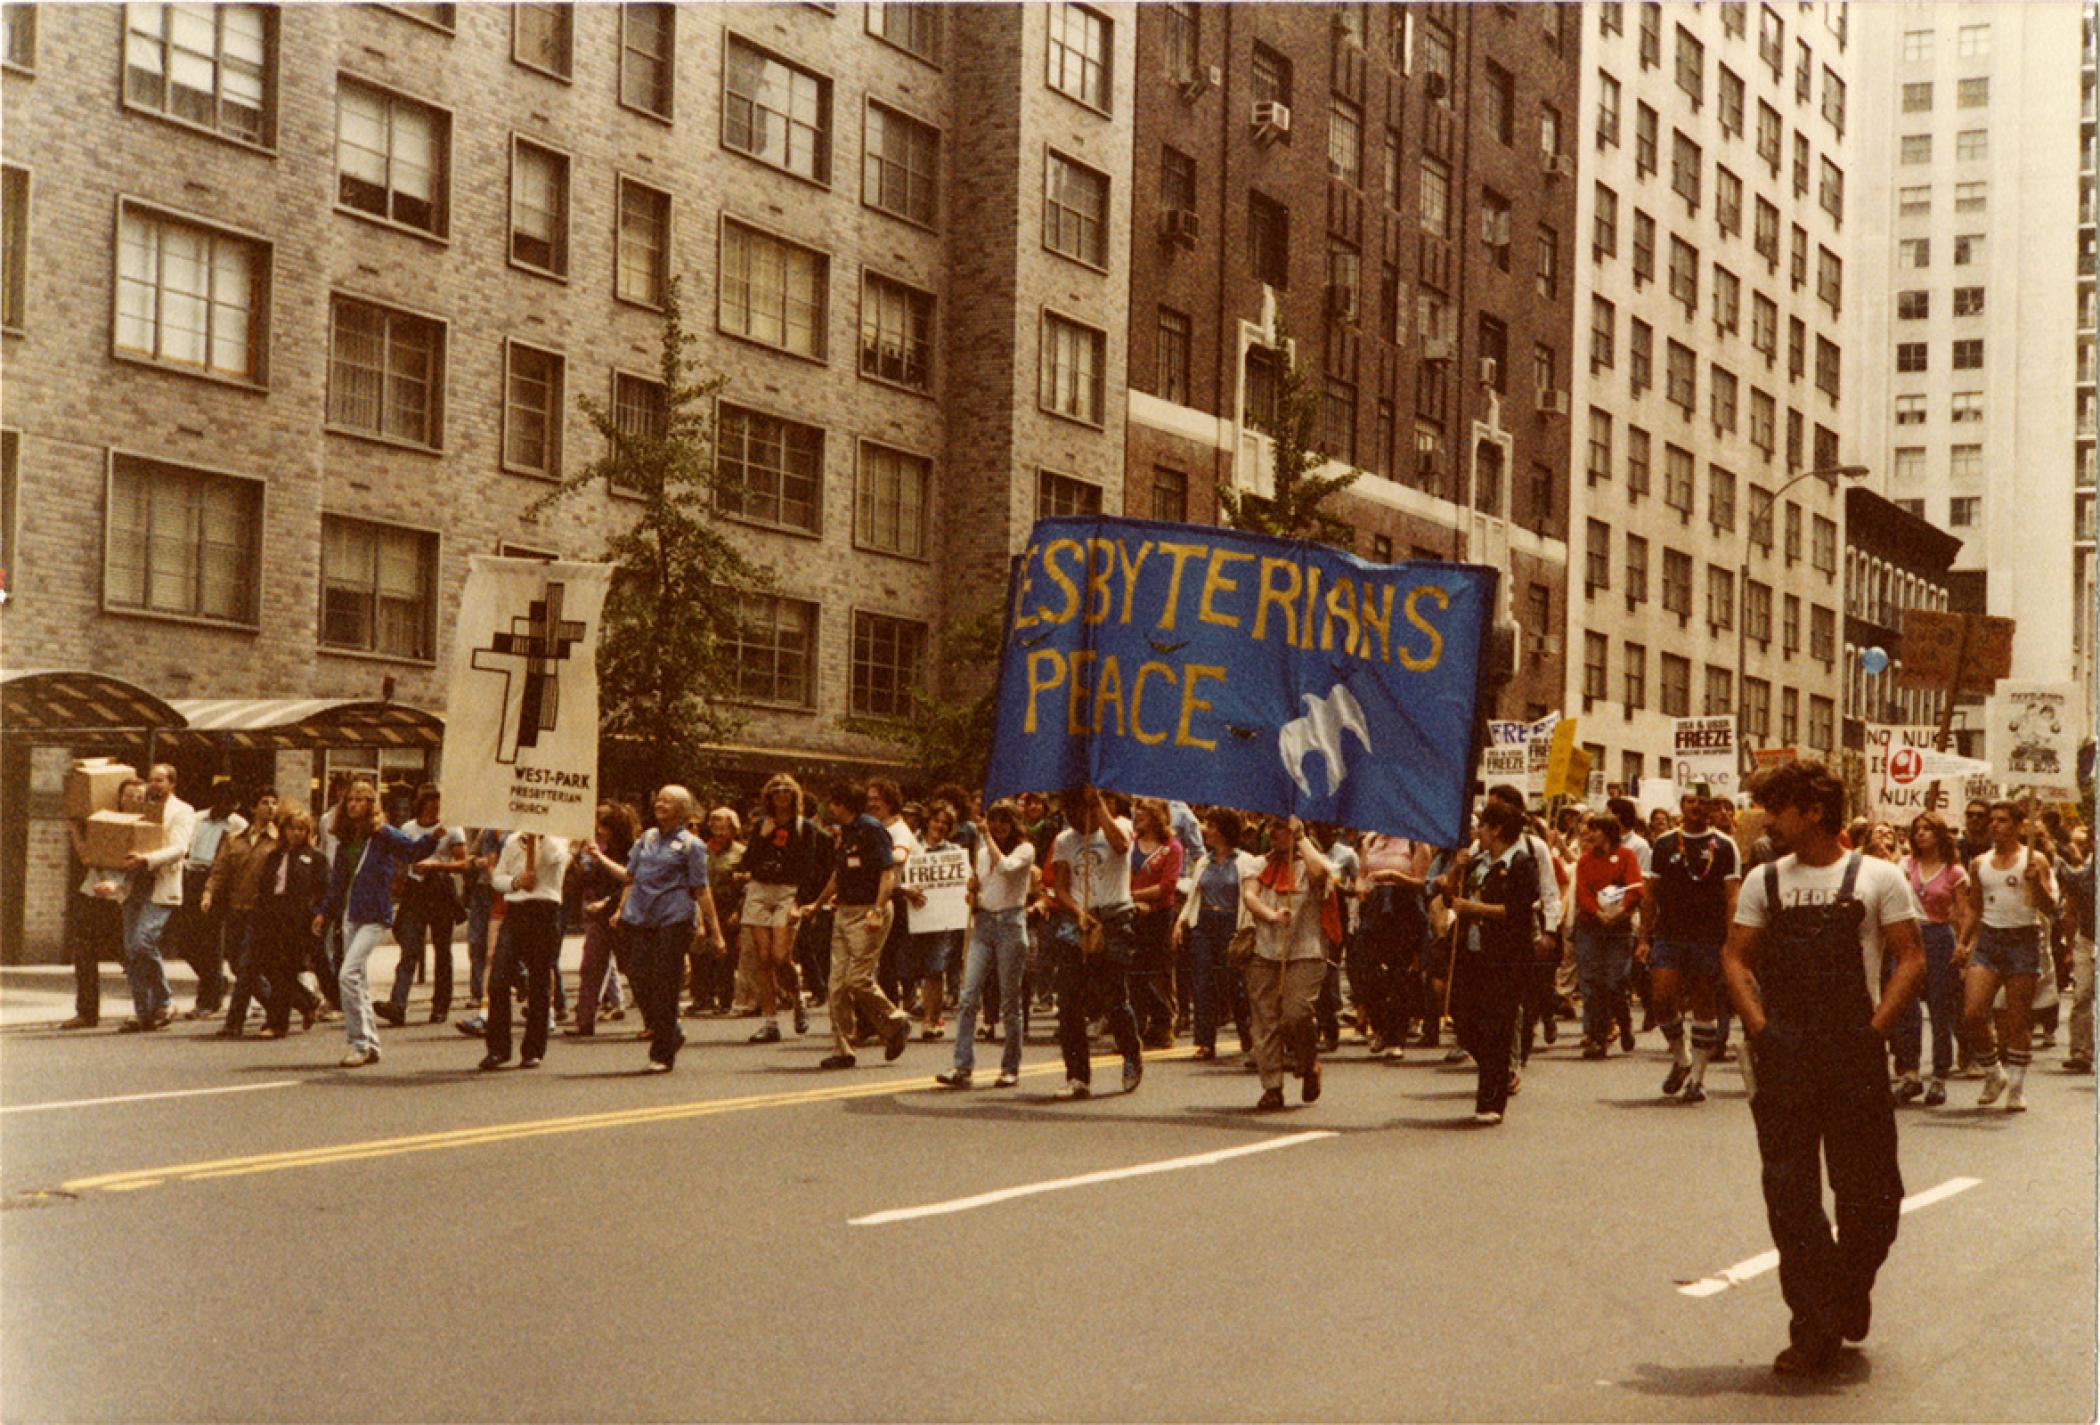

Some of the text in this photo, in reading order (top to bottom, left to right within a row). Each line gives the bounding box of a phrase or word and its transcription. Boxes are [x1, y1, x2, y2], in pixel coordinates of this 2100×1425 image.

[1023, 649, 1227, 752] PEACE
[1676, 730, 1732, 749] FREEZE
[1866, 729, 1891, 746] NO
[1487, 757, 1523, 770] FREEZE
[515, 767, 590, 789] WEST-PARK
[511, 786, 582, 803] PRESBYTERIAN
[1880, 788, 1949, 809] NUKS
[509, 801, 549, 815] CHURCH
[909, 863, 965, 883] FREEZE
